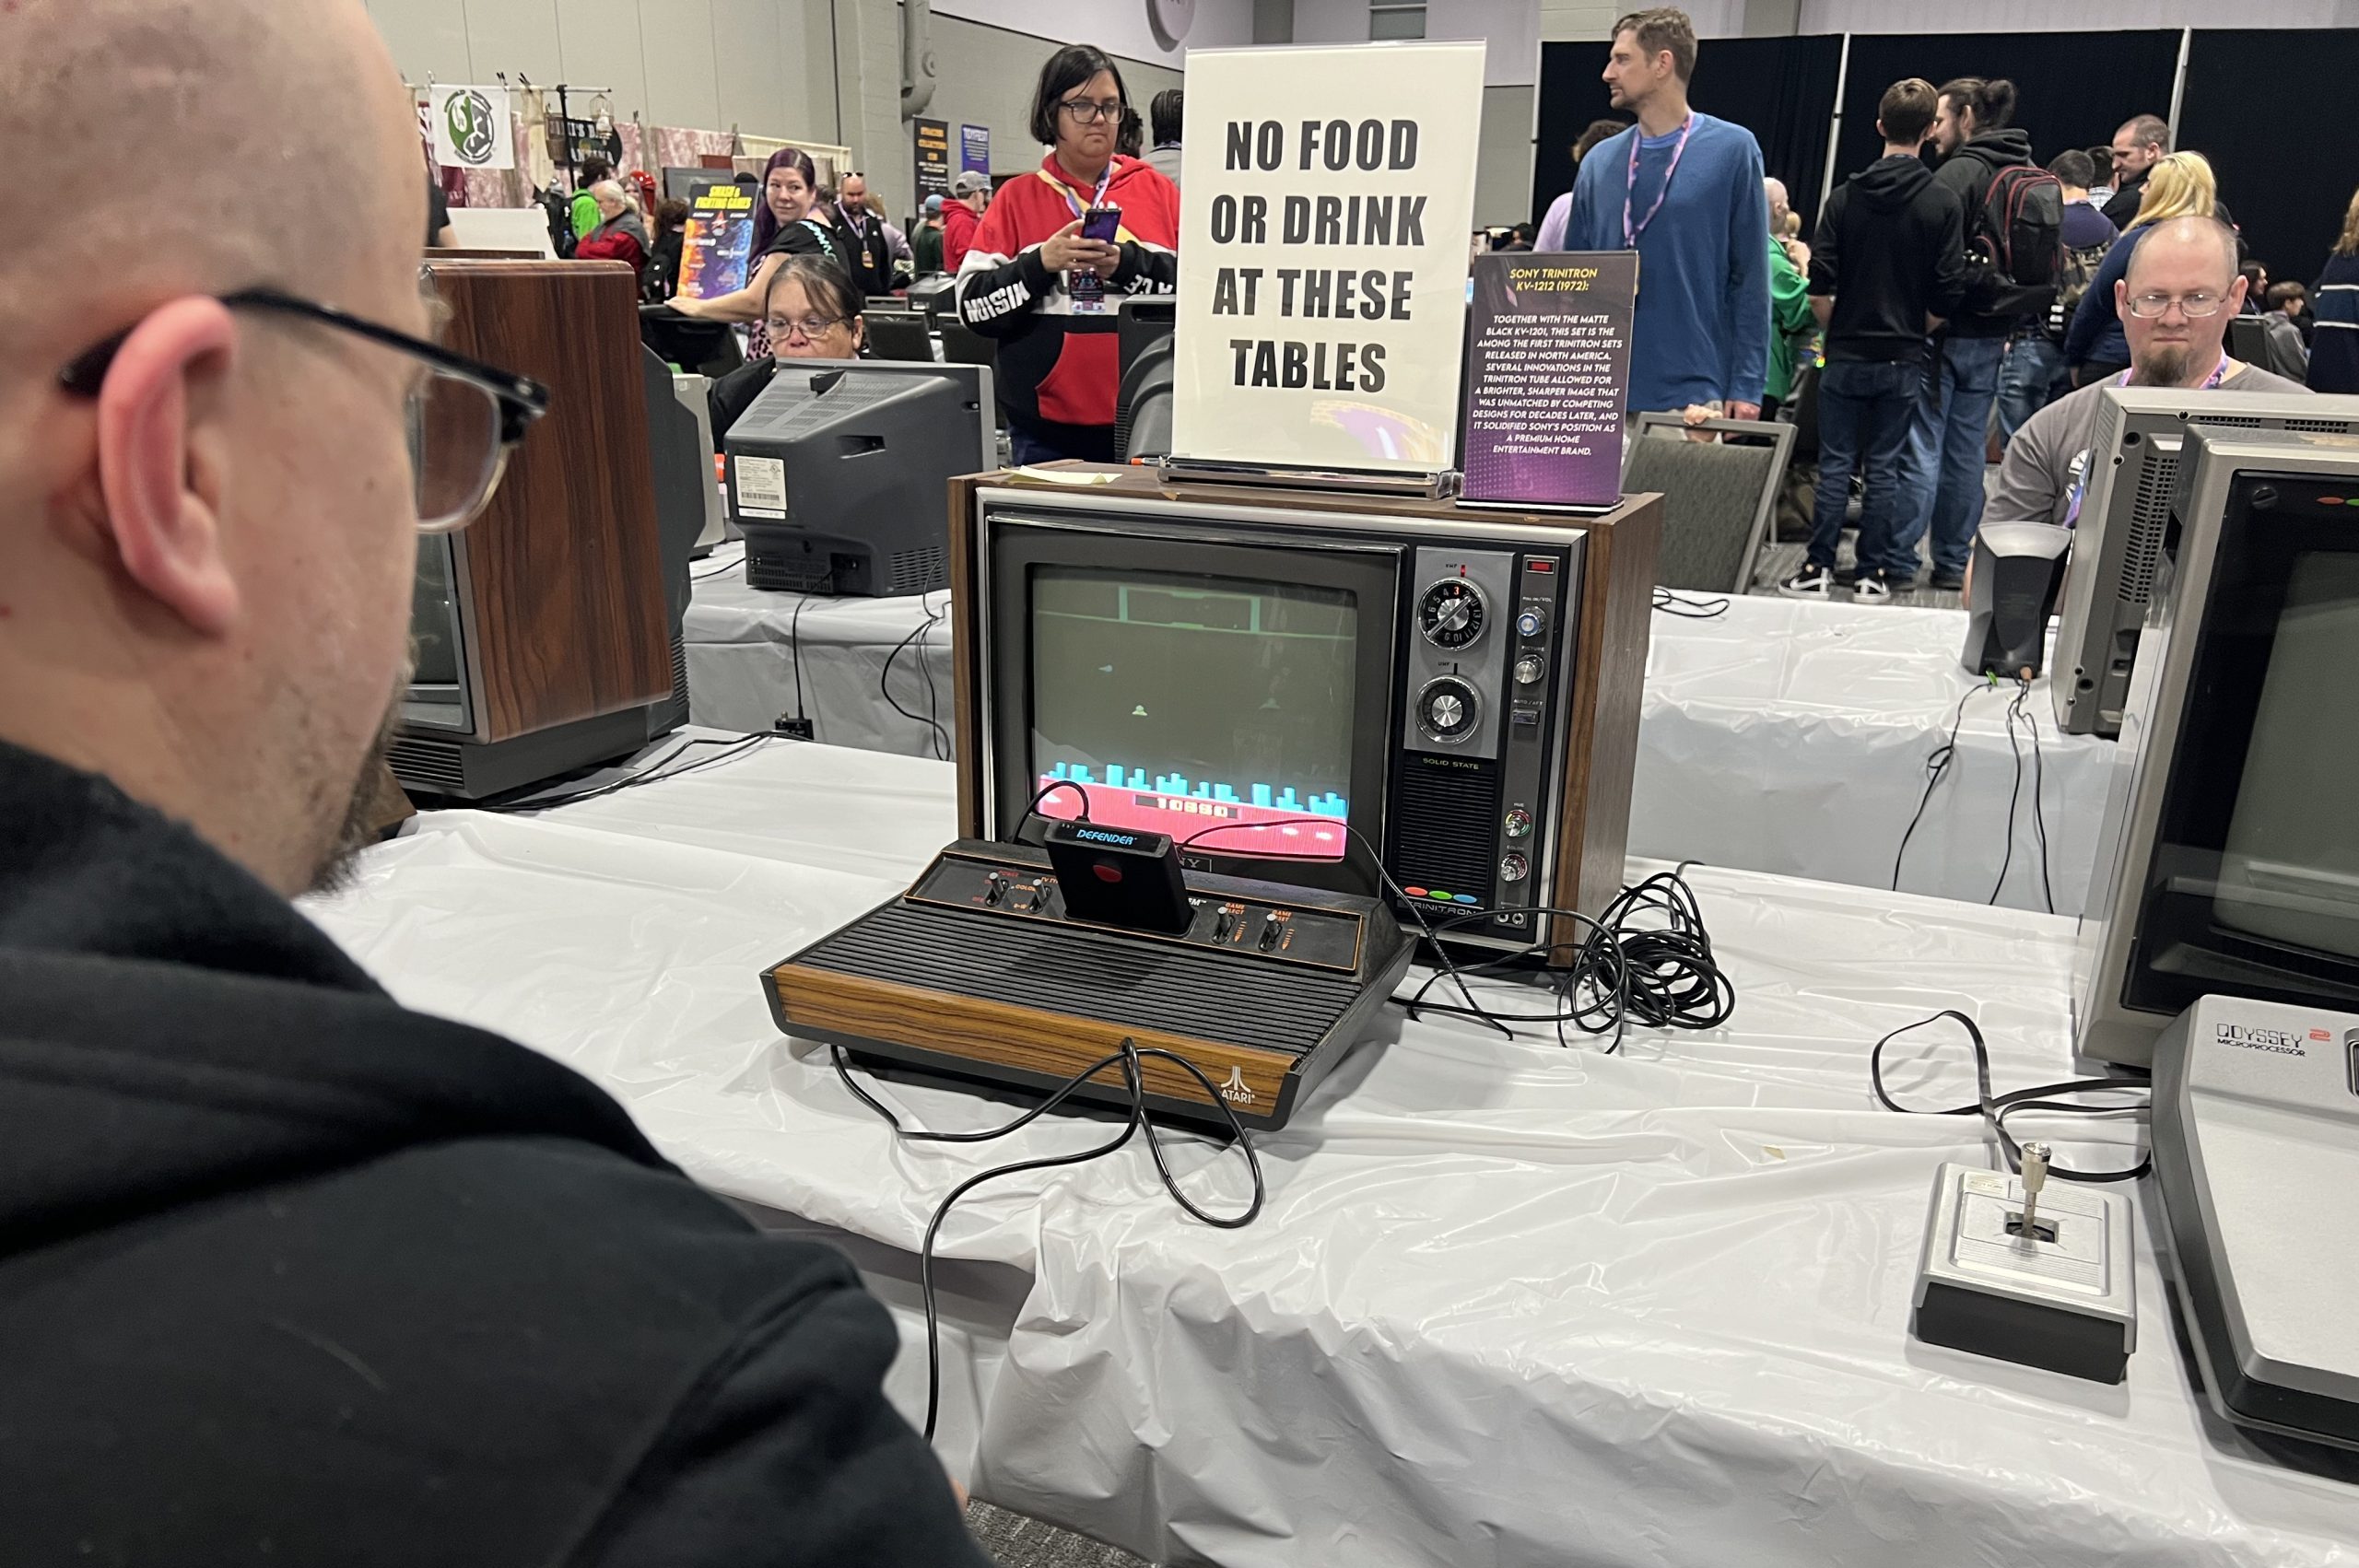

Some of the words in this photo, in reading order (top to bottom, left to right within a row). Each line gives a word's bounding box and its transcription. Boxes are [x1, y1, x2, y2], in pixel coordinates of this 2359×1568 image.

[1226, 120, 1284, 171] NO
[1299, 119, 1418, 171] FOOD
[1211, 194, 1267, 244] OR
[1282, 195, 1427, 246] DRINK
[1509, 269, 1540, 279] SONY
[1542, 268, 1598, 278] TRINITRON
[1516, 281, 1555, 291] KV-1212
[1556, 280, 1590, 292] (1972):
[1212, 267, 1263, 316] AT
[1277, 269, 1414, 321] THESE
[1494, 315, 1537, 324] TOGETHER
[1539, 315, 1561, 324] WITH
[1562, 315, 1579, 324] THE
[1579, 315, 1609, 324] MATTE
[1486, 327, 1512, 336] BLACK
[1551, 327, 1568, 336] THIS
[1570, 327, 1587, 336] SET
[1588, 327, 1596, 336] IS
[1598, 327, 1614, 336] THE
[1477, 339, 1510, 347] AMONG
[1513, 339, 1528, 347] THE
[1530, 339, 1553, 348] FIRST
[1555, 340, 1600, 348] TRINITRON
[1602, 340, 1623, 348] SETS
[1485, 351, 1526, 359] RELEASED
[1527, 351, 1537, 360] IN
[1539, 352, 1568, 360] NORTH
[1569, 352, 1612, 360] AMERICA.
[1230, 339, 1386, 393] TABLES
[1485, 363, 1521, 371] SEVERAL
[1523, 363, 1580, 372] INNOVATIONS
[1582, 364, 1592, 372] IN
[1594, 364, 1611, 372] THE
[1484, 375, 1527, 383] TRINITRON
[1529, 375, 1549, 384] TUBE
[1550, 376, 1591, 384] ALLOWED
[1593, 376, 1612, 385] FOR
[1483, 387, 1525, 396] BRIGHTER,
[1527, 387, 1565, 396] SHARPER
[1567, 388, 1595, 396] IMAGE
[1597, 388, 1619, 397] THAT
[1497, 399, 1548, 407] UNMATCHED
[1562, 400, 1614, 409] COMPETING
[1473, 410, 1508, 418] DESIGNS
[1509, 411, 1526, 419] FOR
[1529, 411, 1567, 419] DECADES
[1568, 412, 1596, 421] LATER,
[1599, 412, 1618, 421] AND
[1473, 421, 1481, 429] IT
[1483, 422, 1527, 430] SOLIDIFIED
[1529, 422, 1559, 431] SONY'S
[1561, 423, 1601, 432] POSITION
[1602, 424, 1615, 432] AS
[1506, 434, 1513, 442] A
[1514, 435, 1552, 443] PREMIUM
[1555, 435, 1580, 444] HOME
[1493, 445, 1559, 454] ENTERTAINMENT
[1561, 447, 1592, 456] BRAND.
[1443, 588, 1449, 596] 4
[1453, 586, 1460, 595] 3
[1433, 595, 1441, 603] 5
[1473, 609, 1482, 618] 13
[1423, 757, 1449, 766] SOLID
[1452, 762, 1479, 770] STATE
[1076, 828, 1133, 846] DEFENDER
[2216, 1023, 2302, 1047] ODYSSEY
[2308, 1028, 2330, 1042] 2
[2217, 1038, 2306, 1057] MICROPROCESSOR
[1221, 1089, 1251, 1105] ATARI
